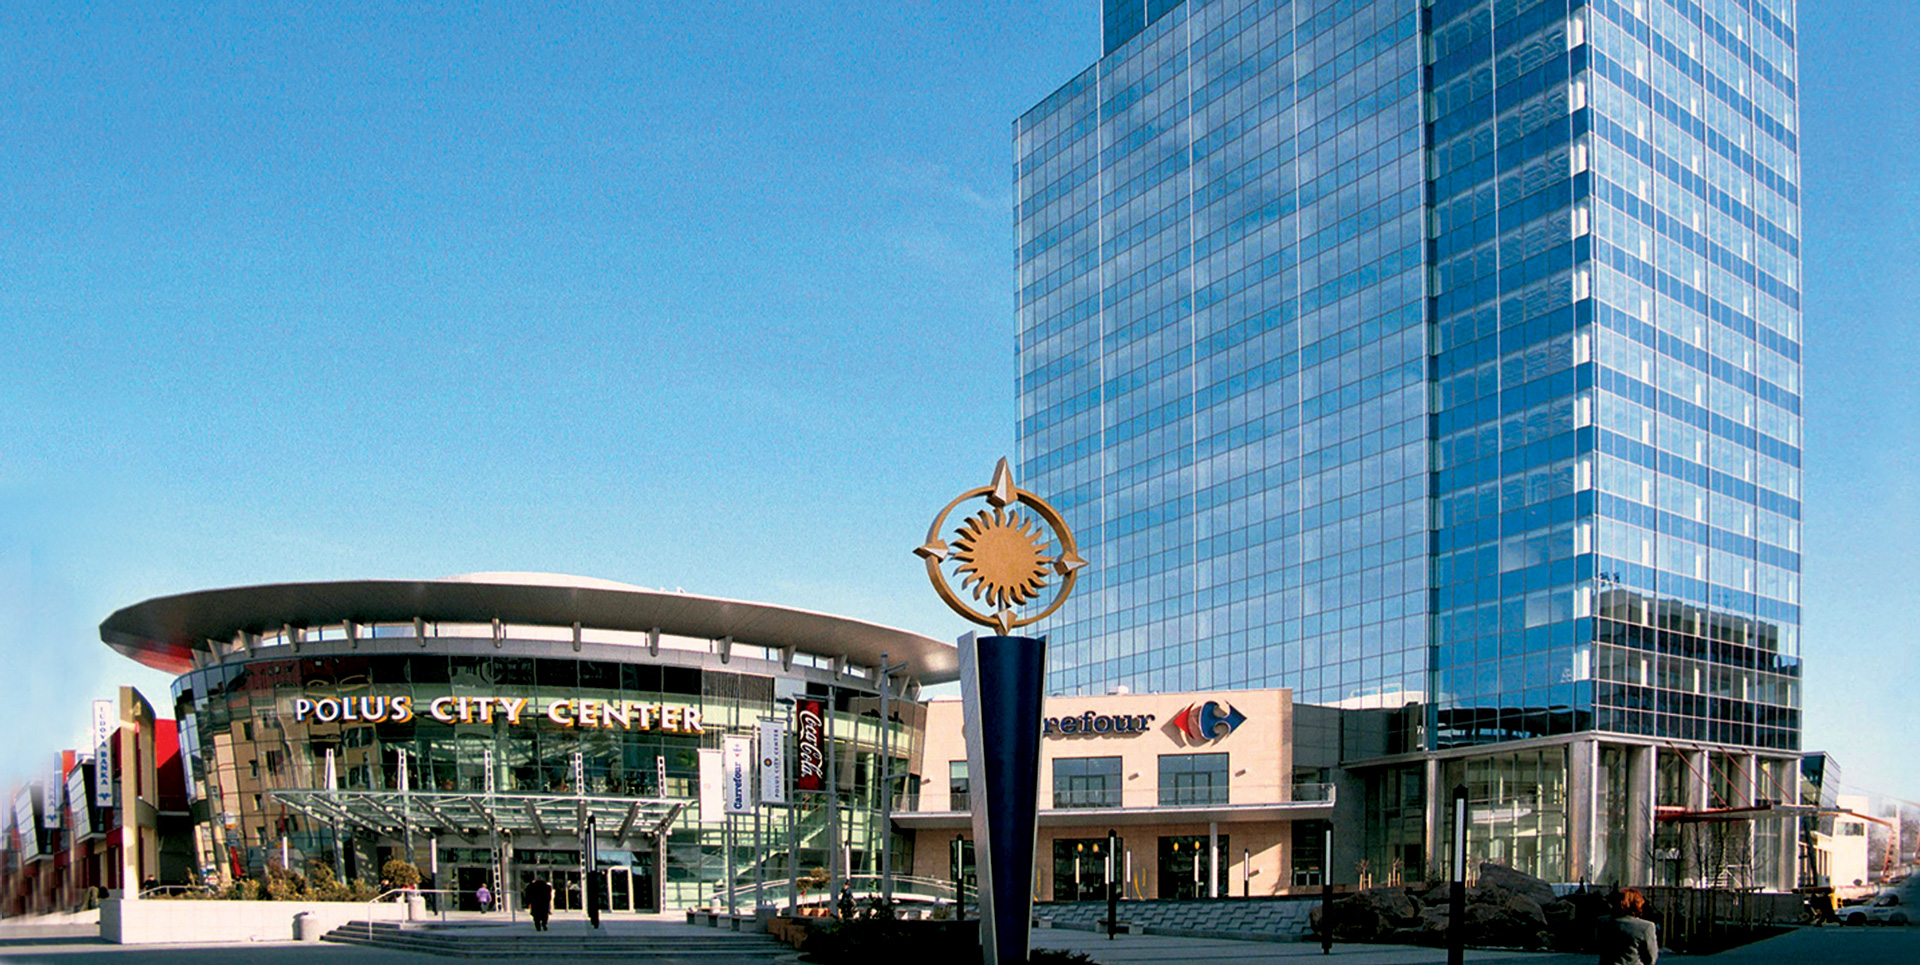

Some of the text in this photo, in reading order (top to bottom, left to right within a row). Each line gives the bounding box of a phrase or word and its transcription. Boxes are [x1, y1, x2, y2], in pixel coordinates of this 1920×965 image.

[296, 696, 704, 734] POLUS CITY CENTER
[800, 710, 823, 779] Coca-Cola
[100, 751, 108, 785] BANKA
[733, 762, 743, 810] Carrefour
